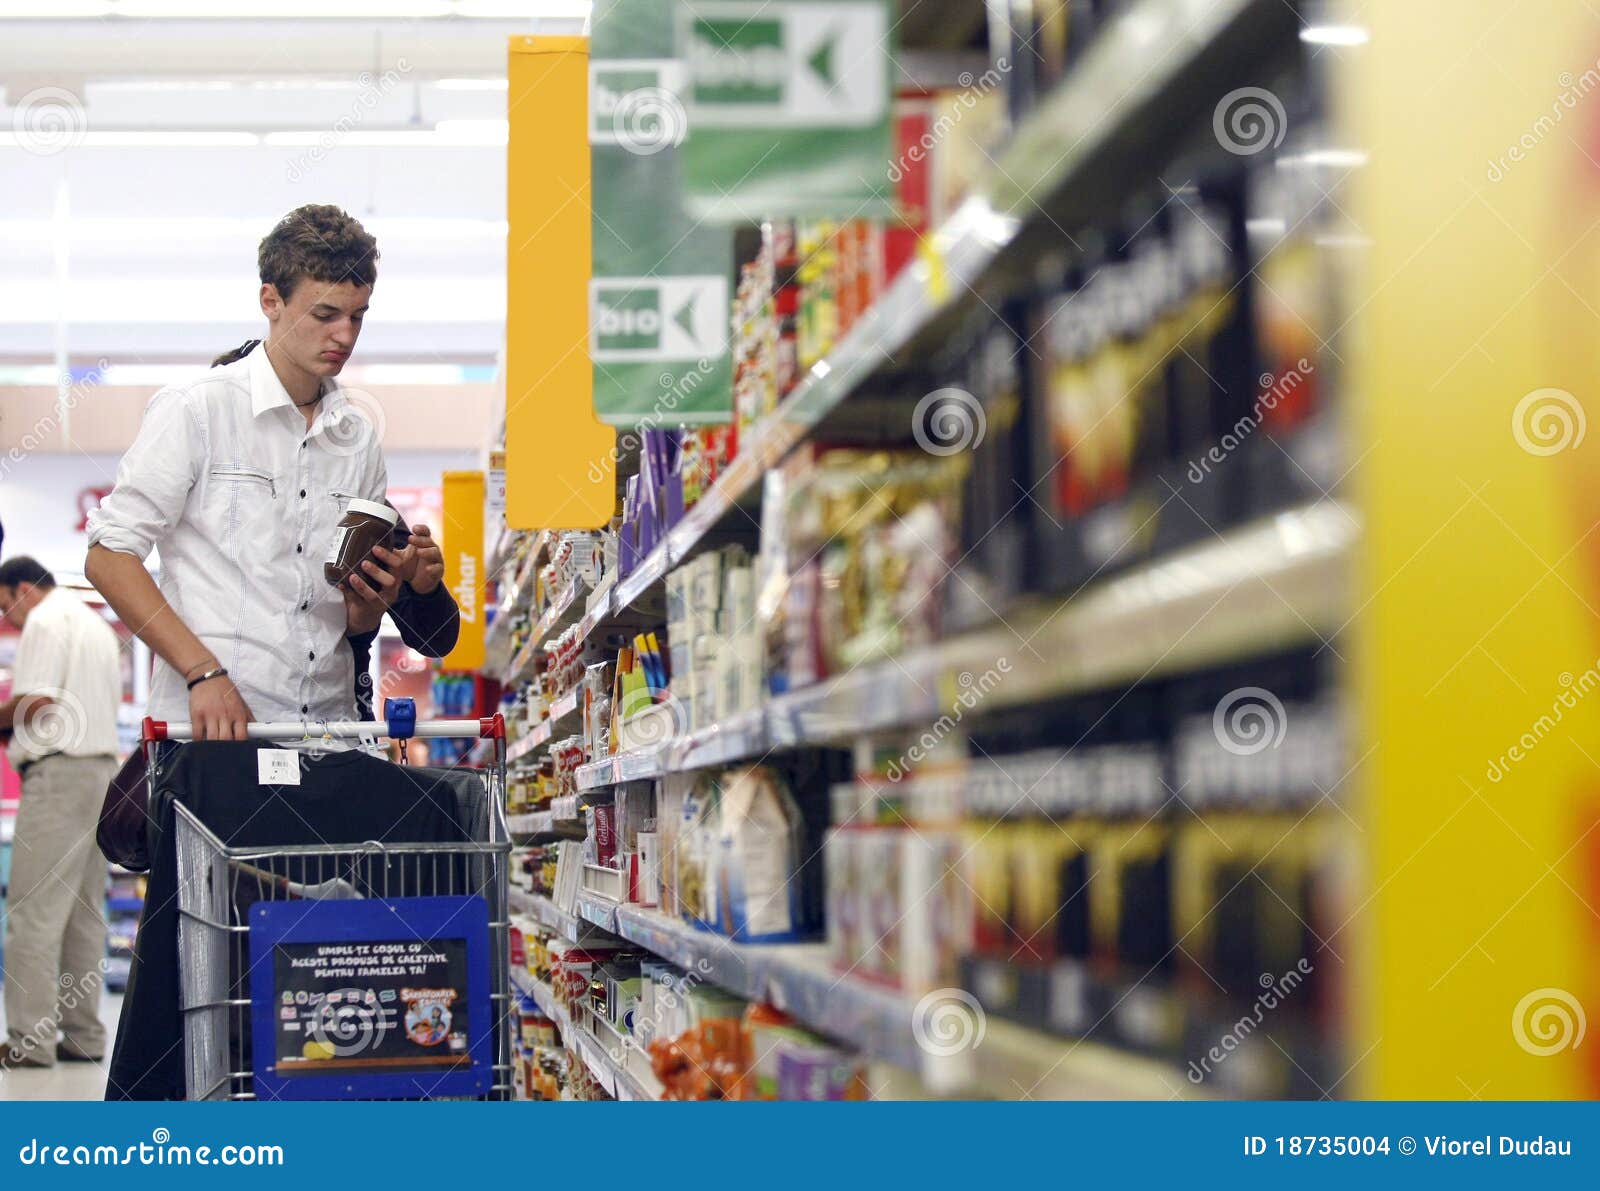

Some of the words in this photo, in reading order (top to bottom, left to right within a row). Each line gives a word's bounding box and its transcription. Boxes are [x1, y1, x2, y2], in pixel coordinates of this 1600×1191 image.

[599, 301, 660, 336] bio
[453, 551, 476, 623] Zahar
[408, 944, 421, 953] CU
[291, 957, 328, 968] ACESTE
[331, 956, 379, 966] PRODUSE
[382, 955, 394, 965] DE
[397, 953, 447, 964] CALITATE
[314, 968, 354, 978] PENTRU
[357, 966, 406, 977] FAMILIA
[409, 963, 427, 975] TA!
